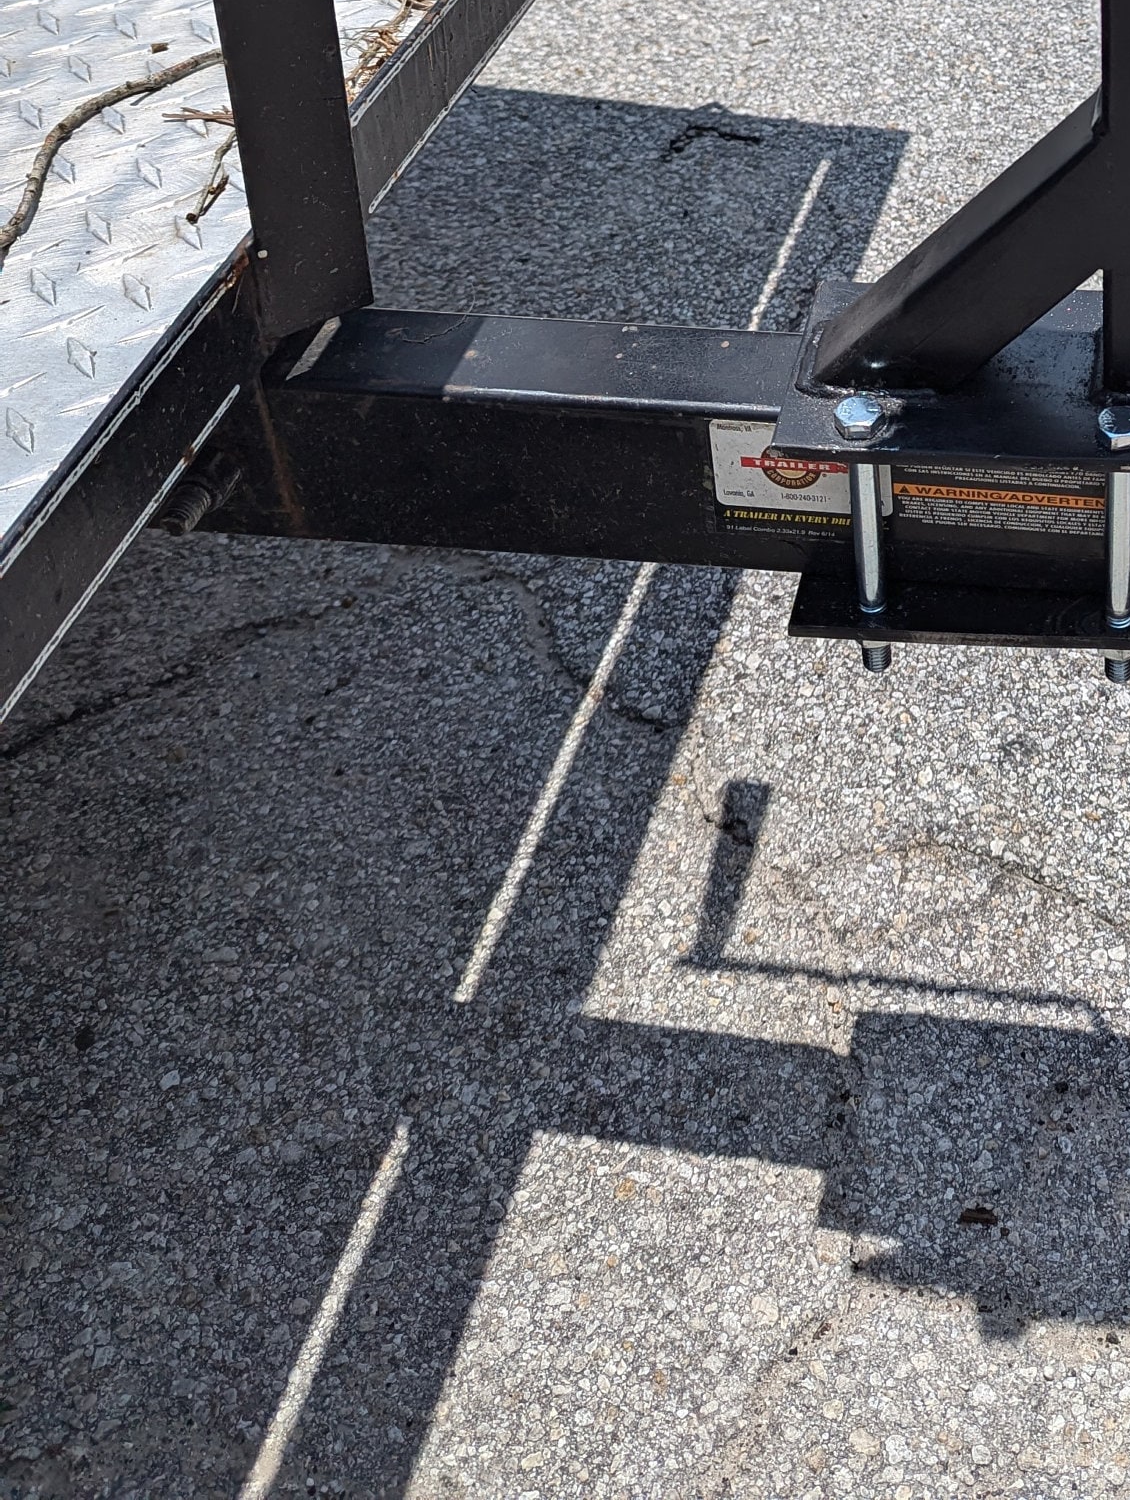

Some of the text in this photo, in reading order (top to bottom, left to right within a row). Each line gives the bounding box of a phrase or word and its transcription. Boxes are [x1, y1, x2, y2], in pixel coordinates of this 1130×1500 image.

[754, 459, 831, 471] TRAILER
[767, 469, 816, 487] CORPORATION
[915, 486, 1104, 507] WARNING/ADVERTEN
[723, 509, 852, 526] A TRAILER IN EVERY DRI
